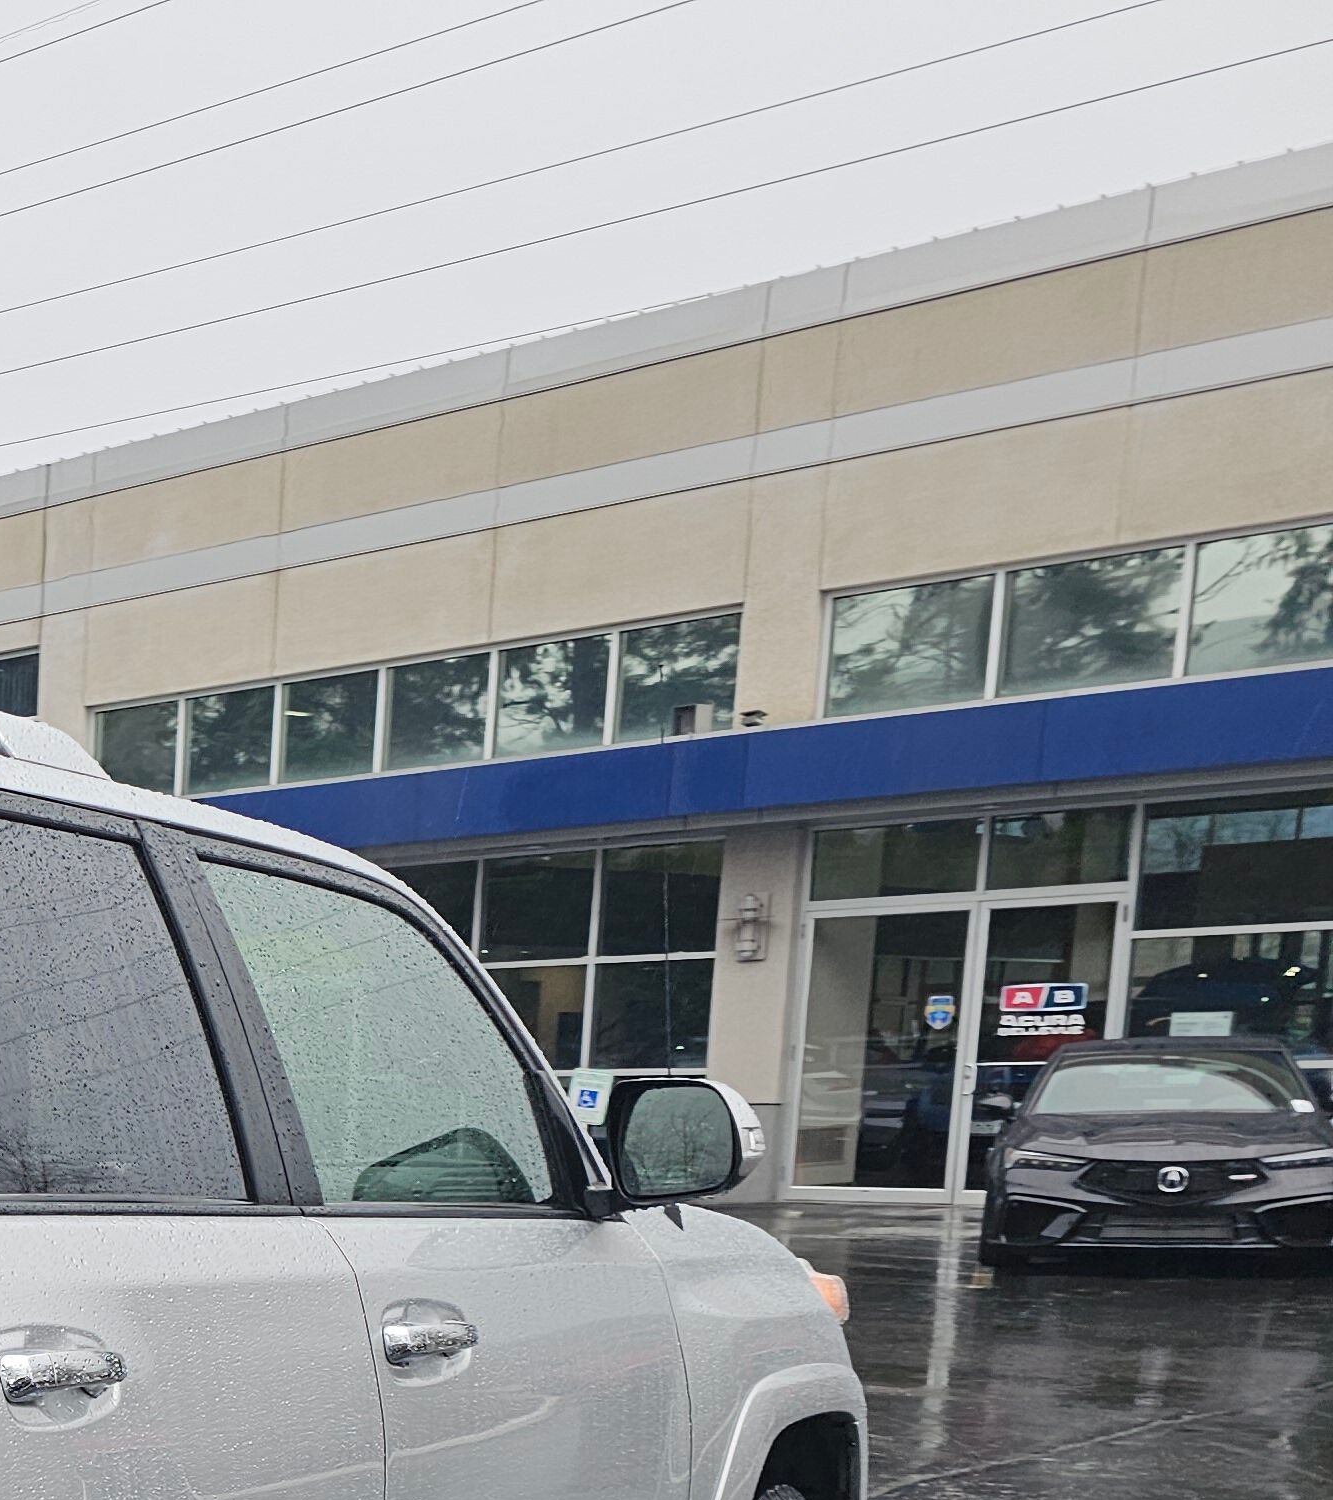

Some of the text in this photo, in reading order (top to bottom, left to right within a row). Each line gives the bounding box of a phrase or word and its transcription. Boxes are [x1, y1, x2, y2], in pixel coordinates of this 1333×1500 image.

[1012, 989, 1076, 1005] A B
[999, 1013, 1086, 1027] ACURA
